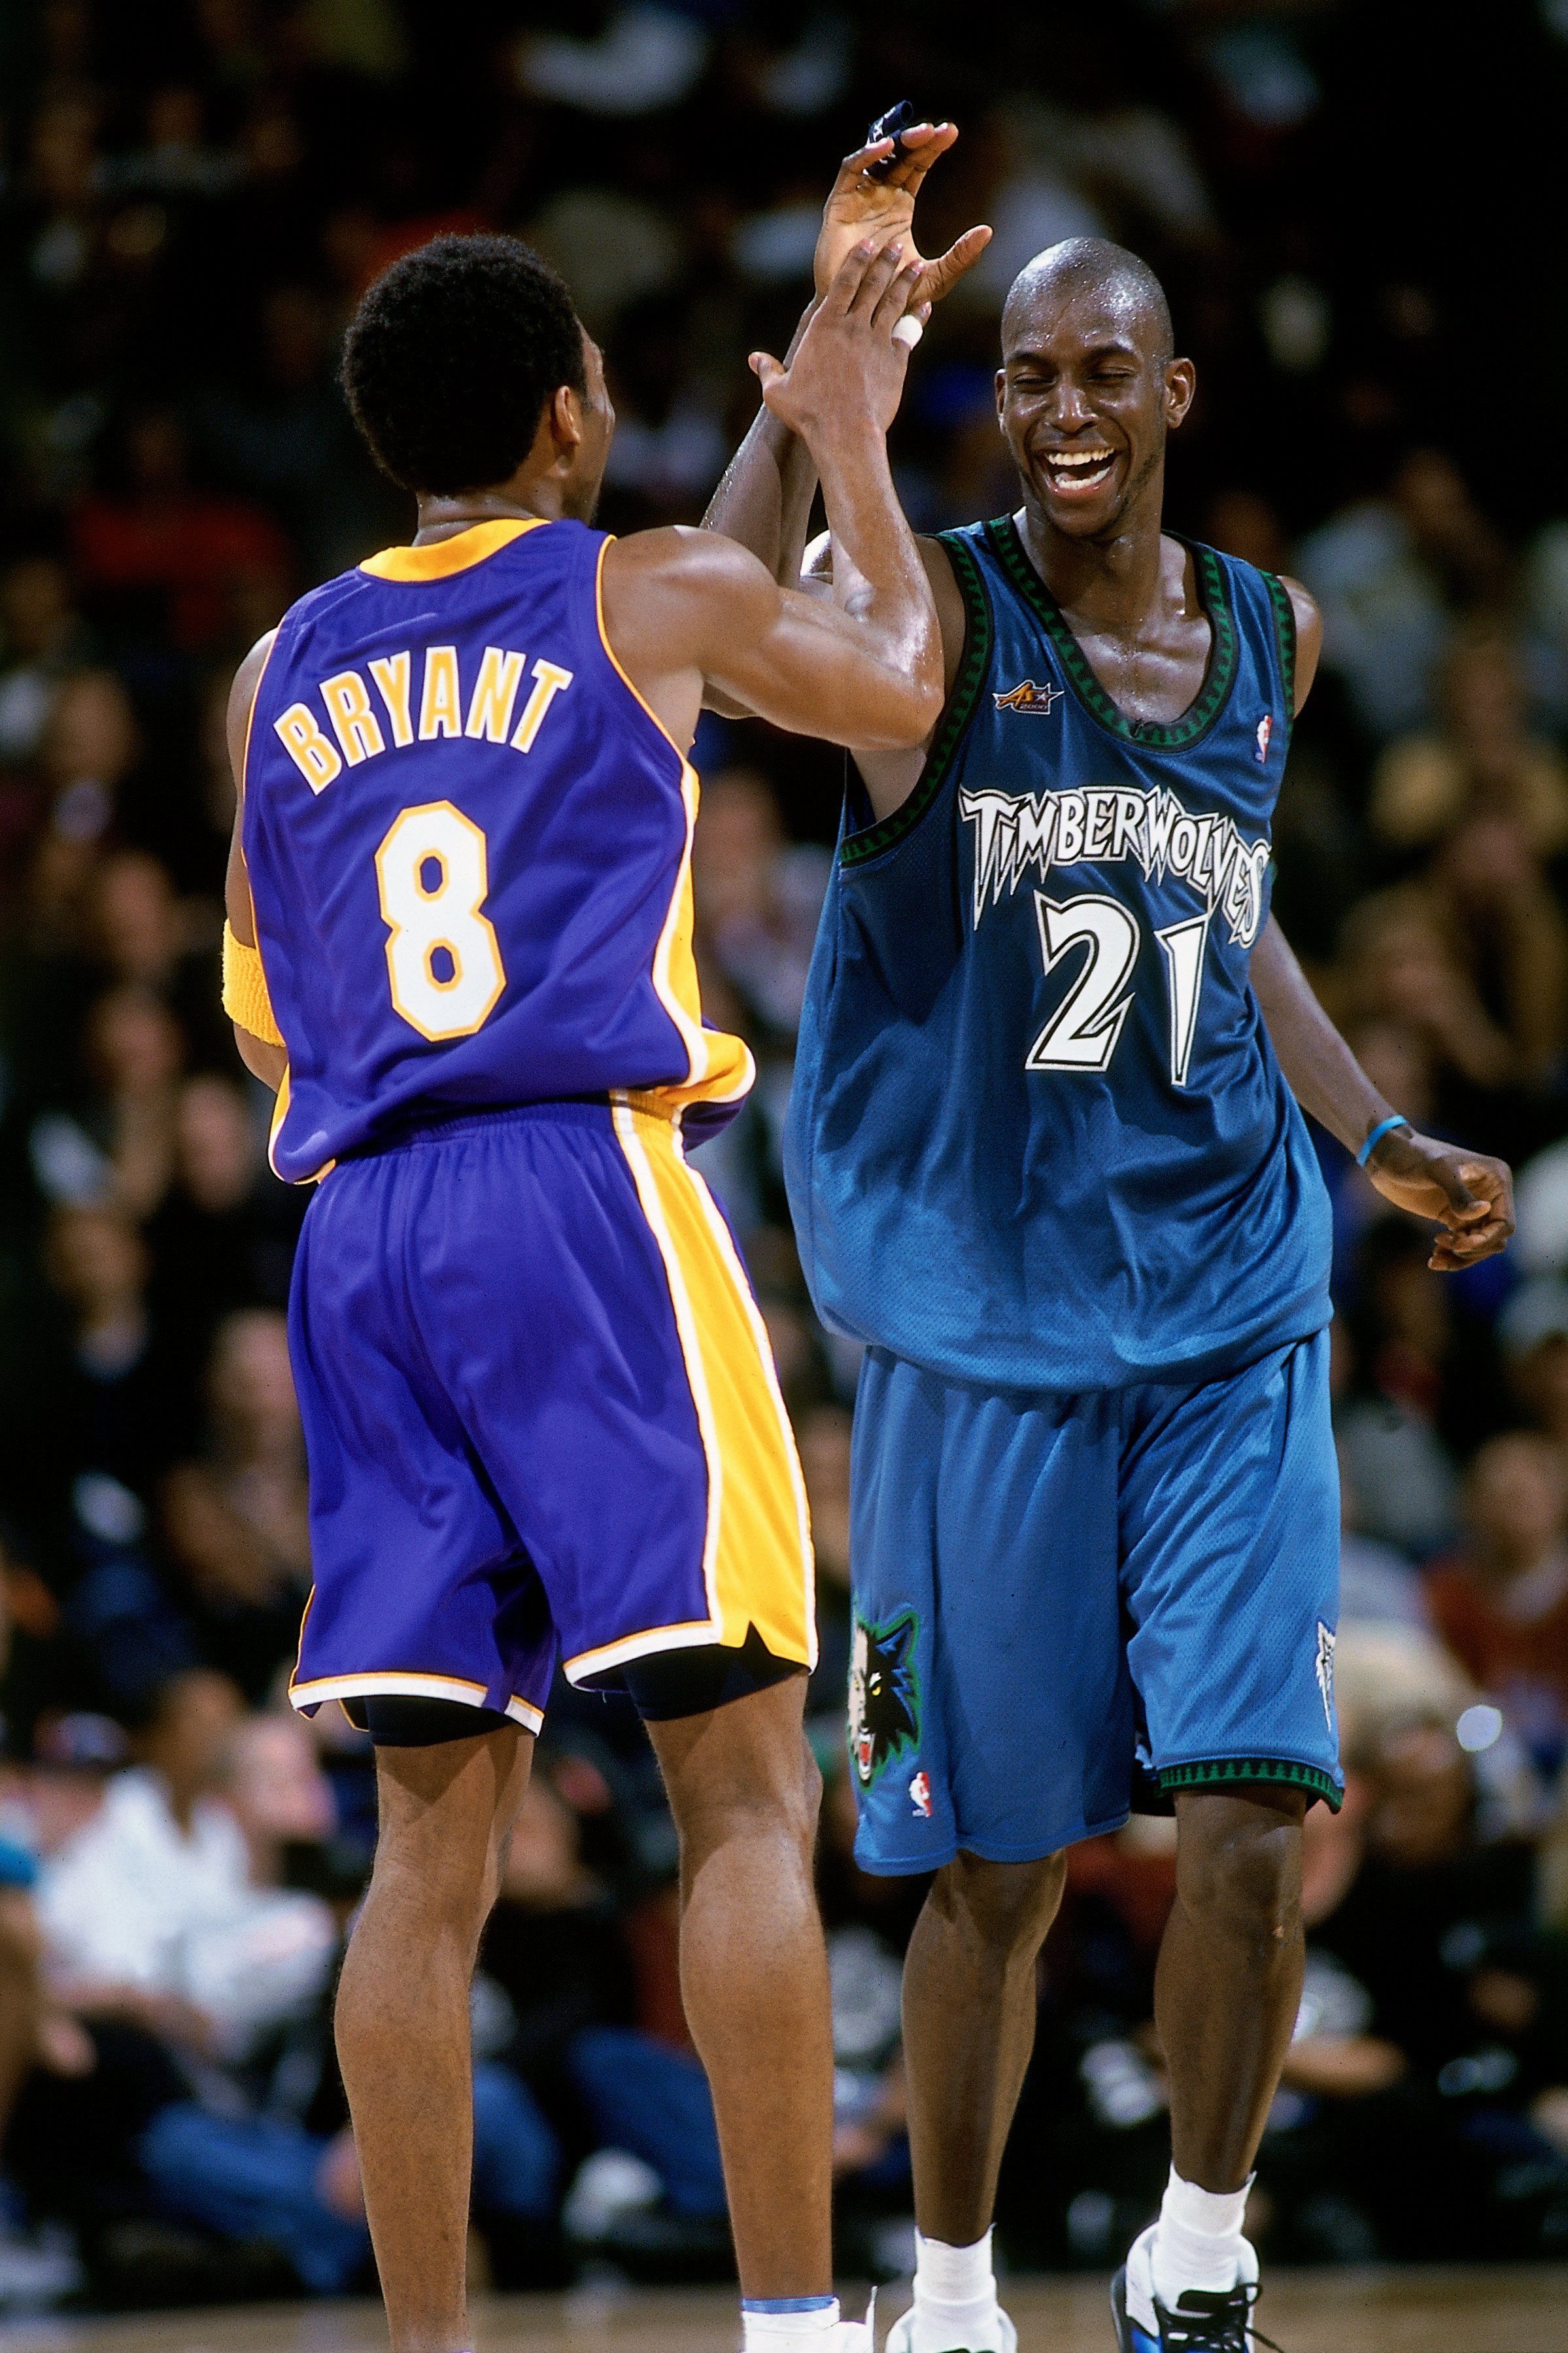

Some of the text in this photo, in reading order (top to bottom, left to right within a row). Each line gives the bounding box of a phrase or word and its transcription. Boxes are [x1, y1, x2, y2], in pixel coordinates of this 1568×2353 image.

[273, 645, 573, 795] BRYANT
[375, 800, 506, 1042] 8
[959, 784, 1272, 949] TIMBERWOLVES
[1025, 890, 1210, 1086] 21
